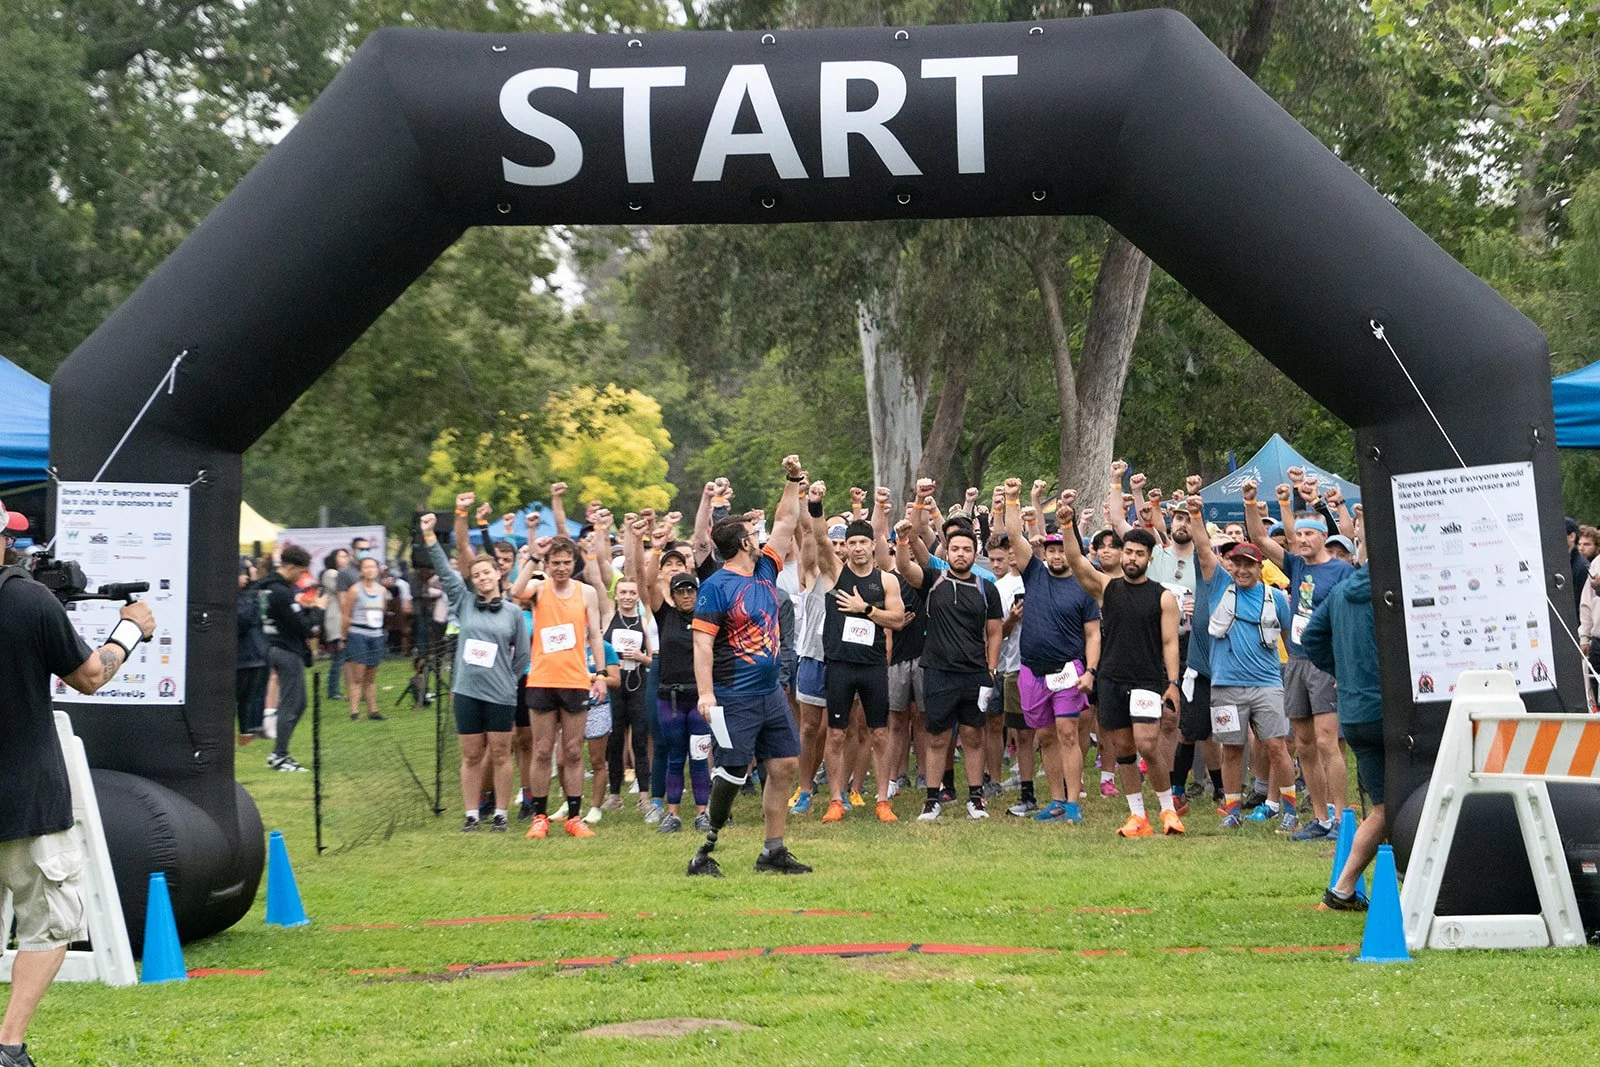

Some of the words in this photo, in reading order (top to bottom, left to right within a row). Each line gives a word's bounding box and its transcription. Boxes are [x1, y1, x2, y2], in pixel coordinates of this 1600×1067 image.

[499, 55, 1019, 186] START
[1397, 481, 1424, 490] Streets
[1426, 478, 1441, 486] Are
[1443, 476, 1458, 485] For
[1460, 472, 1500, 483] Everyone
[1500, 468, 1524, 478] would
[98, 488, 111, 496] For
[113, 489, 151, 498] Everyone
[153, 489, 179, 498] would
[1398, 491, 1412, 500] like
[1413, 490, 1422, 498] to
[1423, 486, 1448, 497] thank
[1449, 486, 1464, 494] our
[1466, 482, 1504, 494] sponsors
[1505, 480, 1520, 488] and
[1399, 499, 1445, 510] supporters:
